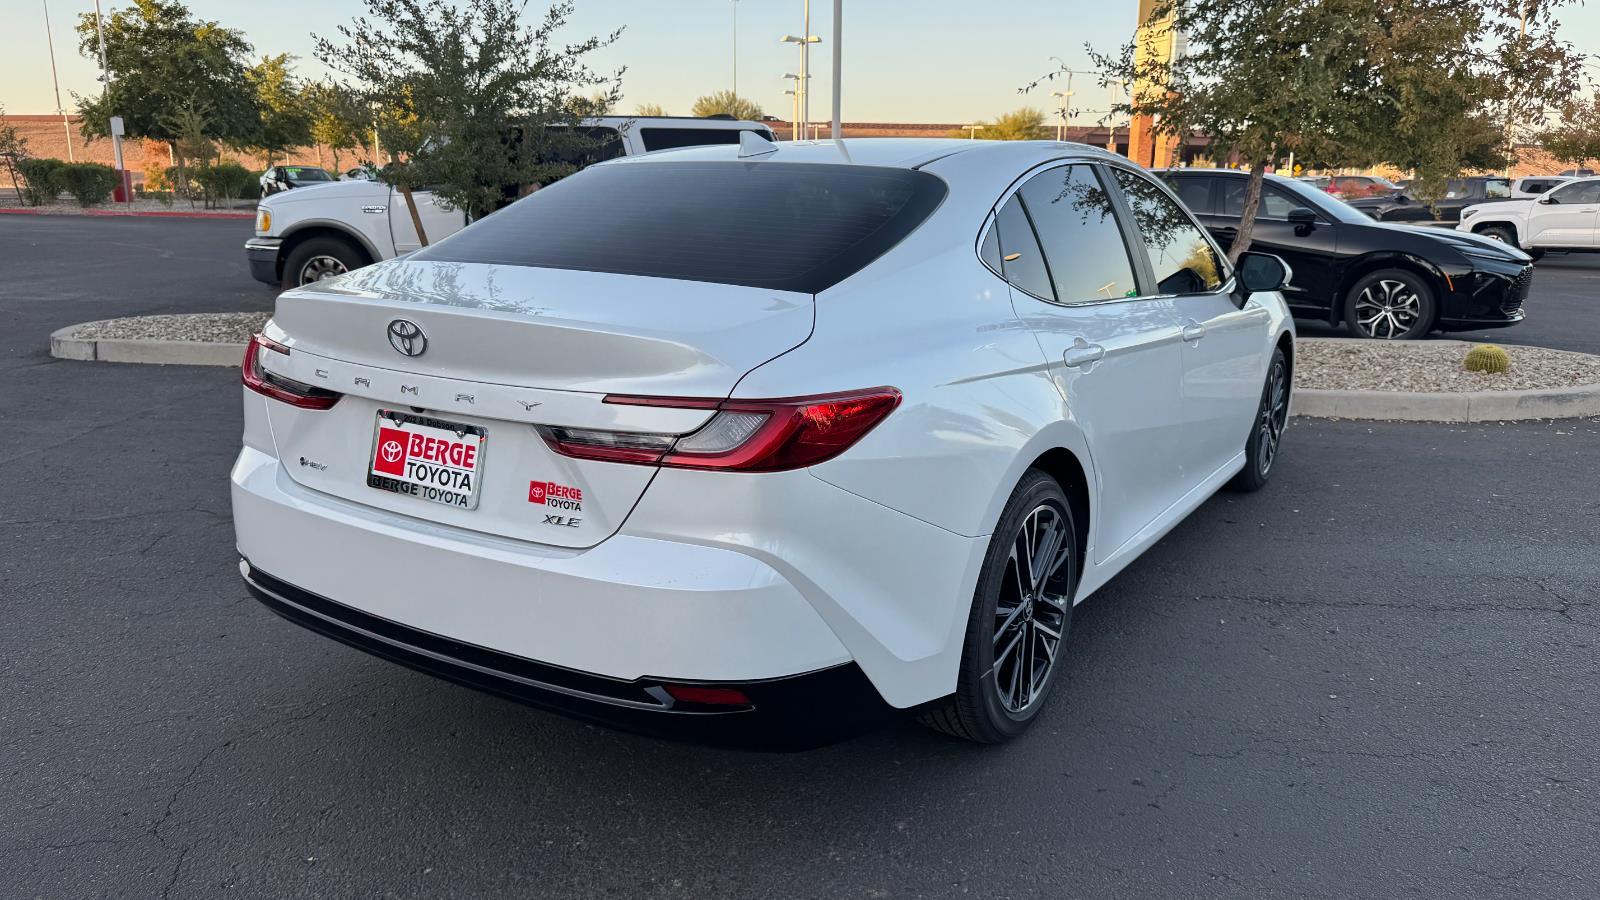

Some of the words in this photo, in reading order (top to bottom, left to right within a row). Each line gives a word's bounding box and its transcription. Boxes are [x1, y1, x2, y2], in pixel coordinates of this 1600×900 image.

[315, 369, 543, 411] CAMRY
[409, 433, 476, 468] BERGE
[372, 475, 418, 495] BERGE
[422, 486, 468, 507] TOYOTA
[407, 462, 472, 491] TOYOTA
[547, 482, 582, 500] BERGE
[546, 498, 581, 511] TOYOTA
[541, 514, 582, 528] XLE
